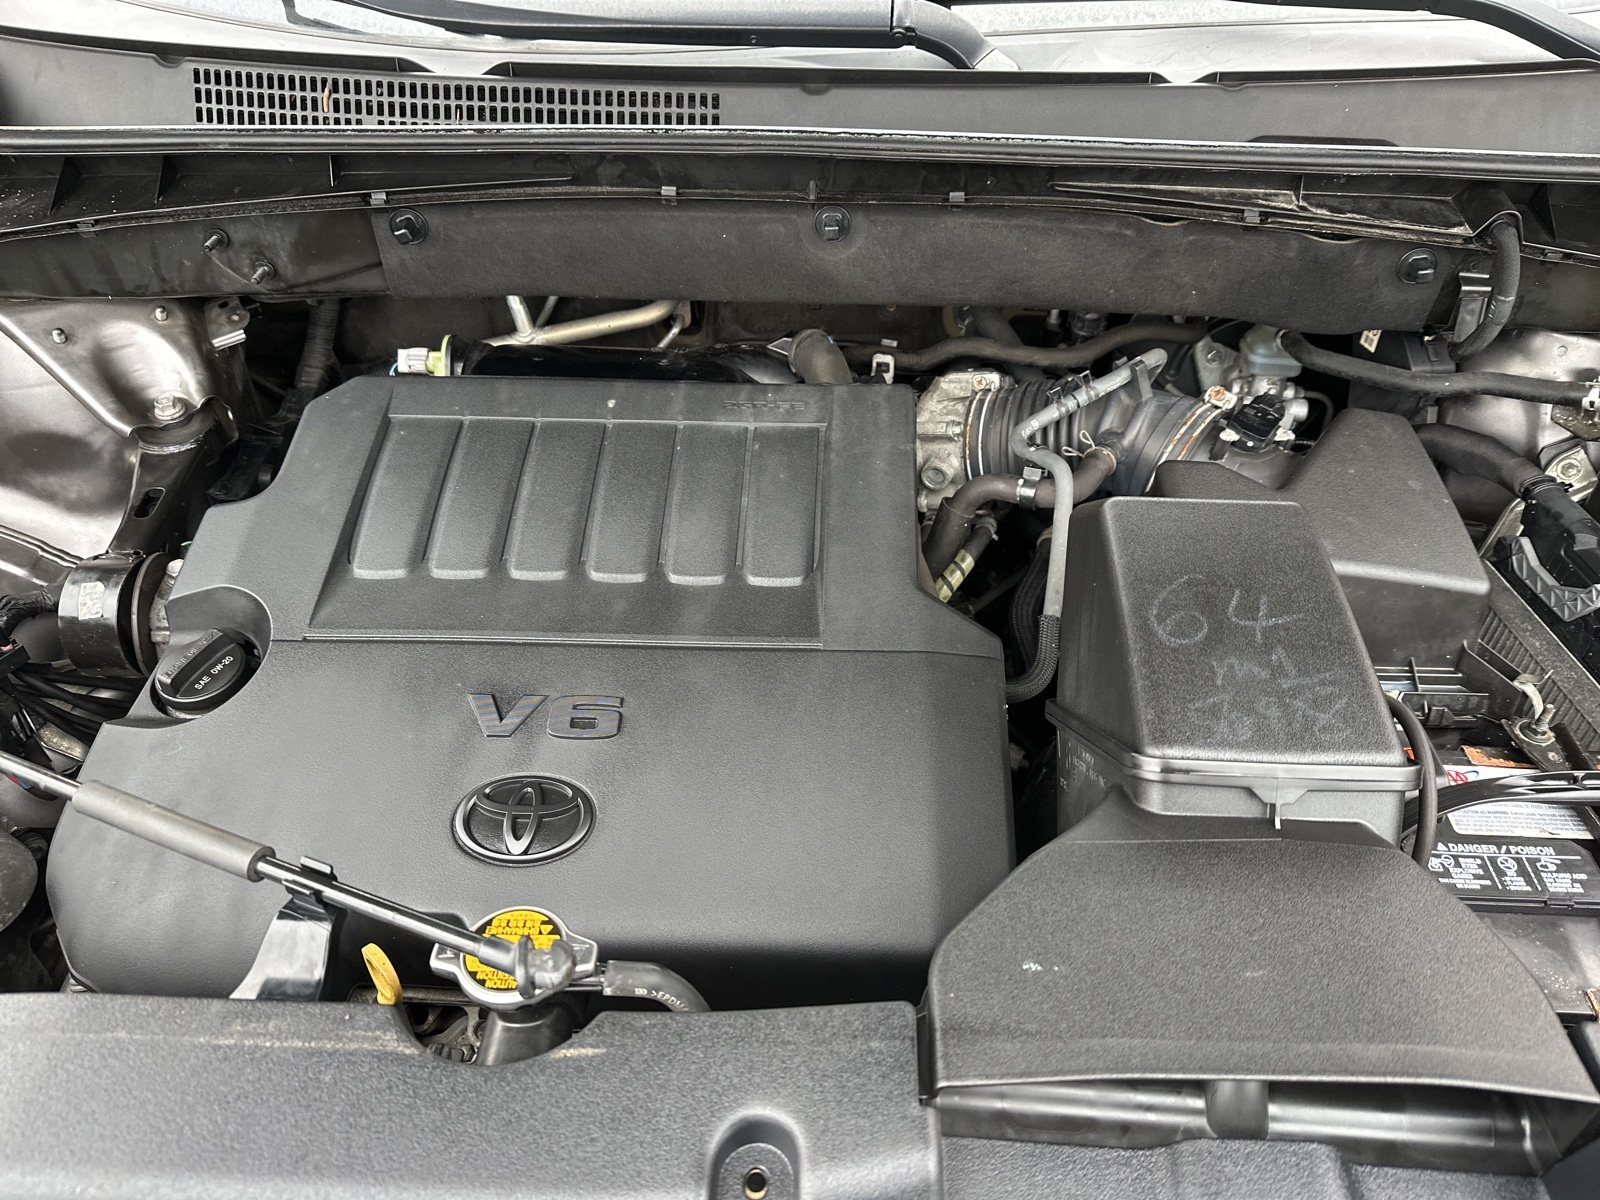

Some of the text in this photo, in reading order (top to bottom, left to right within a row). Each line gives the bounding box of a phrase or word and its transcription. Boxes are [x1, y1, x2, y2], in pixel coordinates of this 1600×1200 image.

[194, 655, 234, 690] SAE 0W-20
[467, 692, 625, 741] V6
[1448, 843, 1499, 854] DANGER
[1508, 845, 1556, 856] POISON
[485, 979, 518, 989] AUTION
